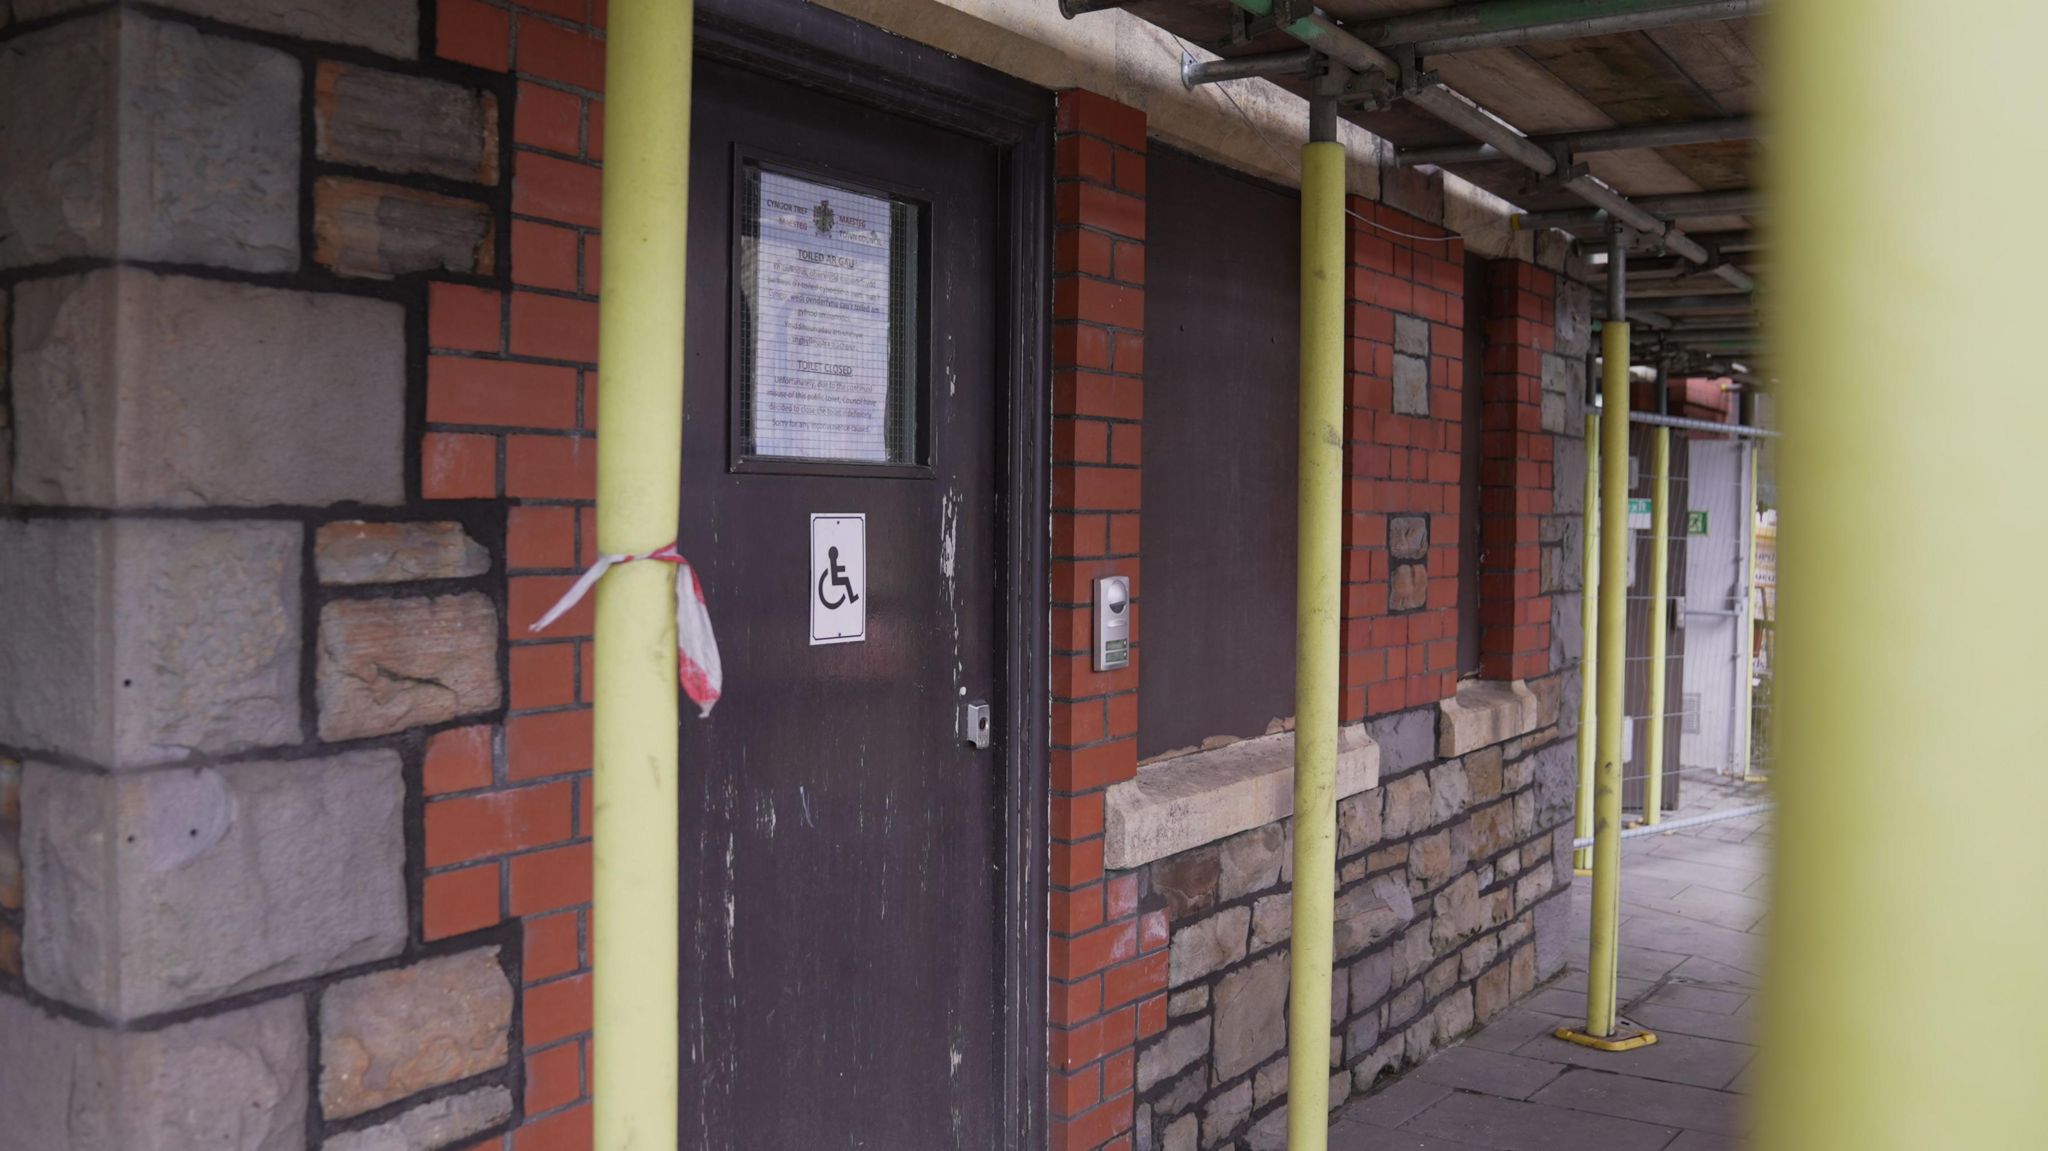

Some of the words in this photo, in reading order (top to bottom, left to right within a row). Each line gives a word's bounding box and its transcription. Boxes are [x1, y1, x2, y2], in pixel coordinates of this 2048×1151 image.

[798, 249, 825, 263] TOILED
[797, 360, 822, 373] TOILET
[823, 363, 853, 376] CLOSED
